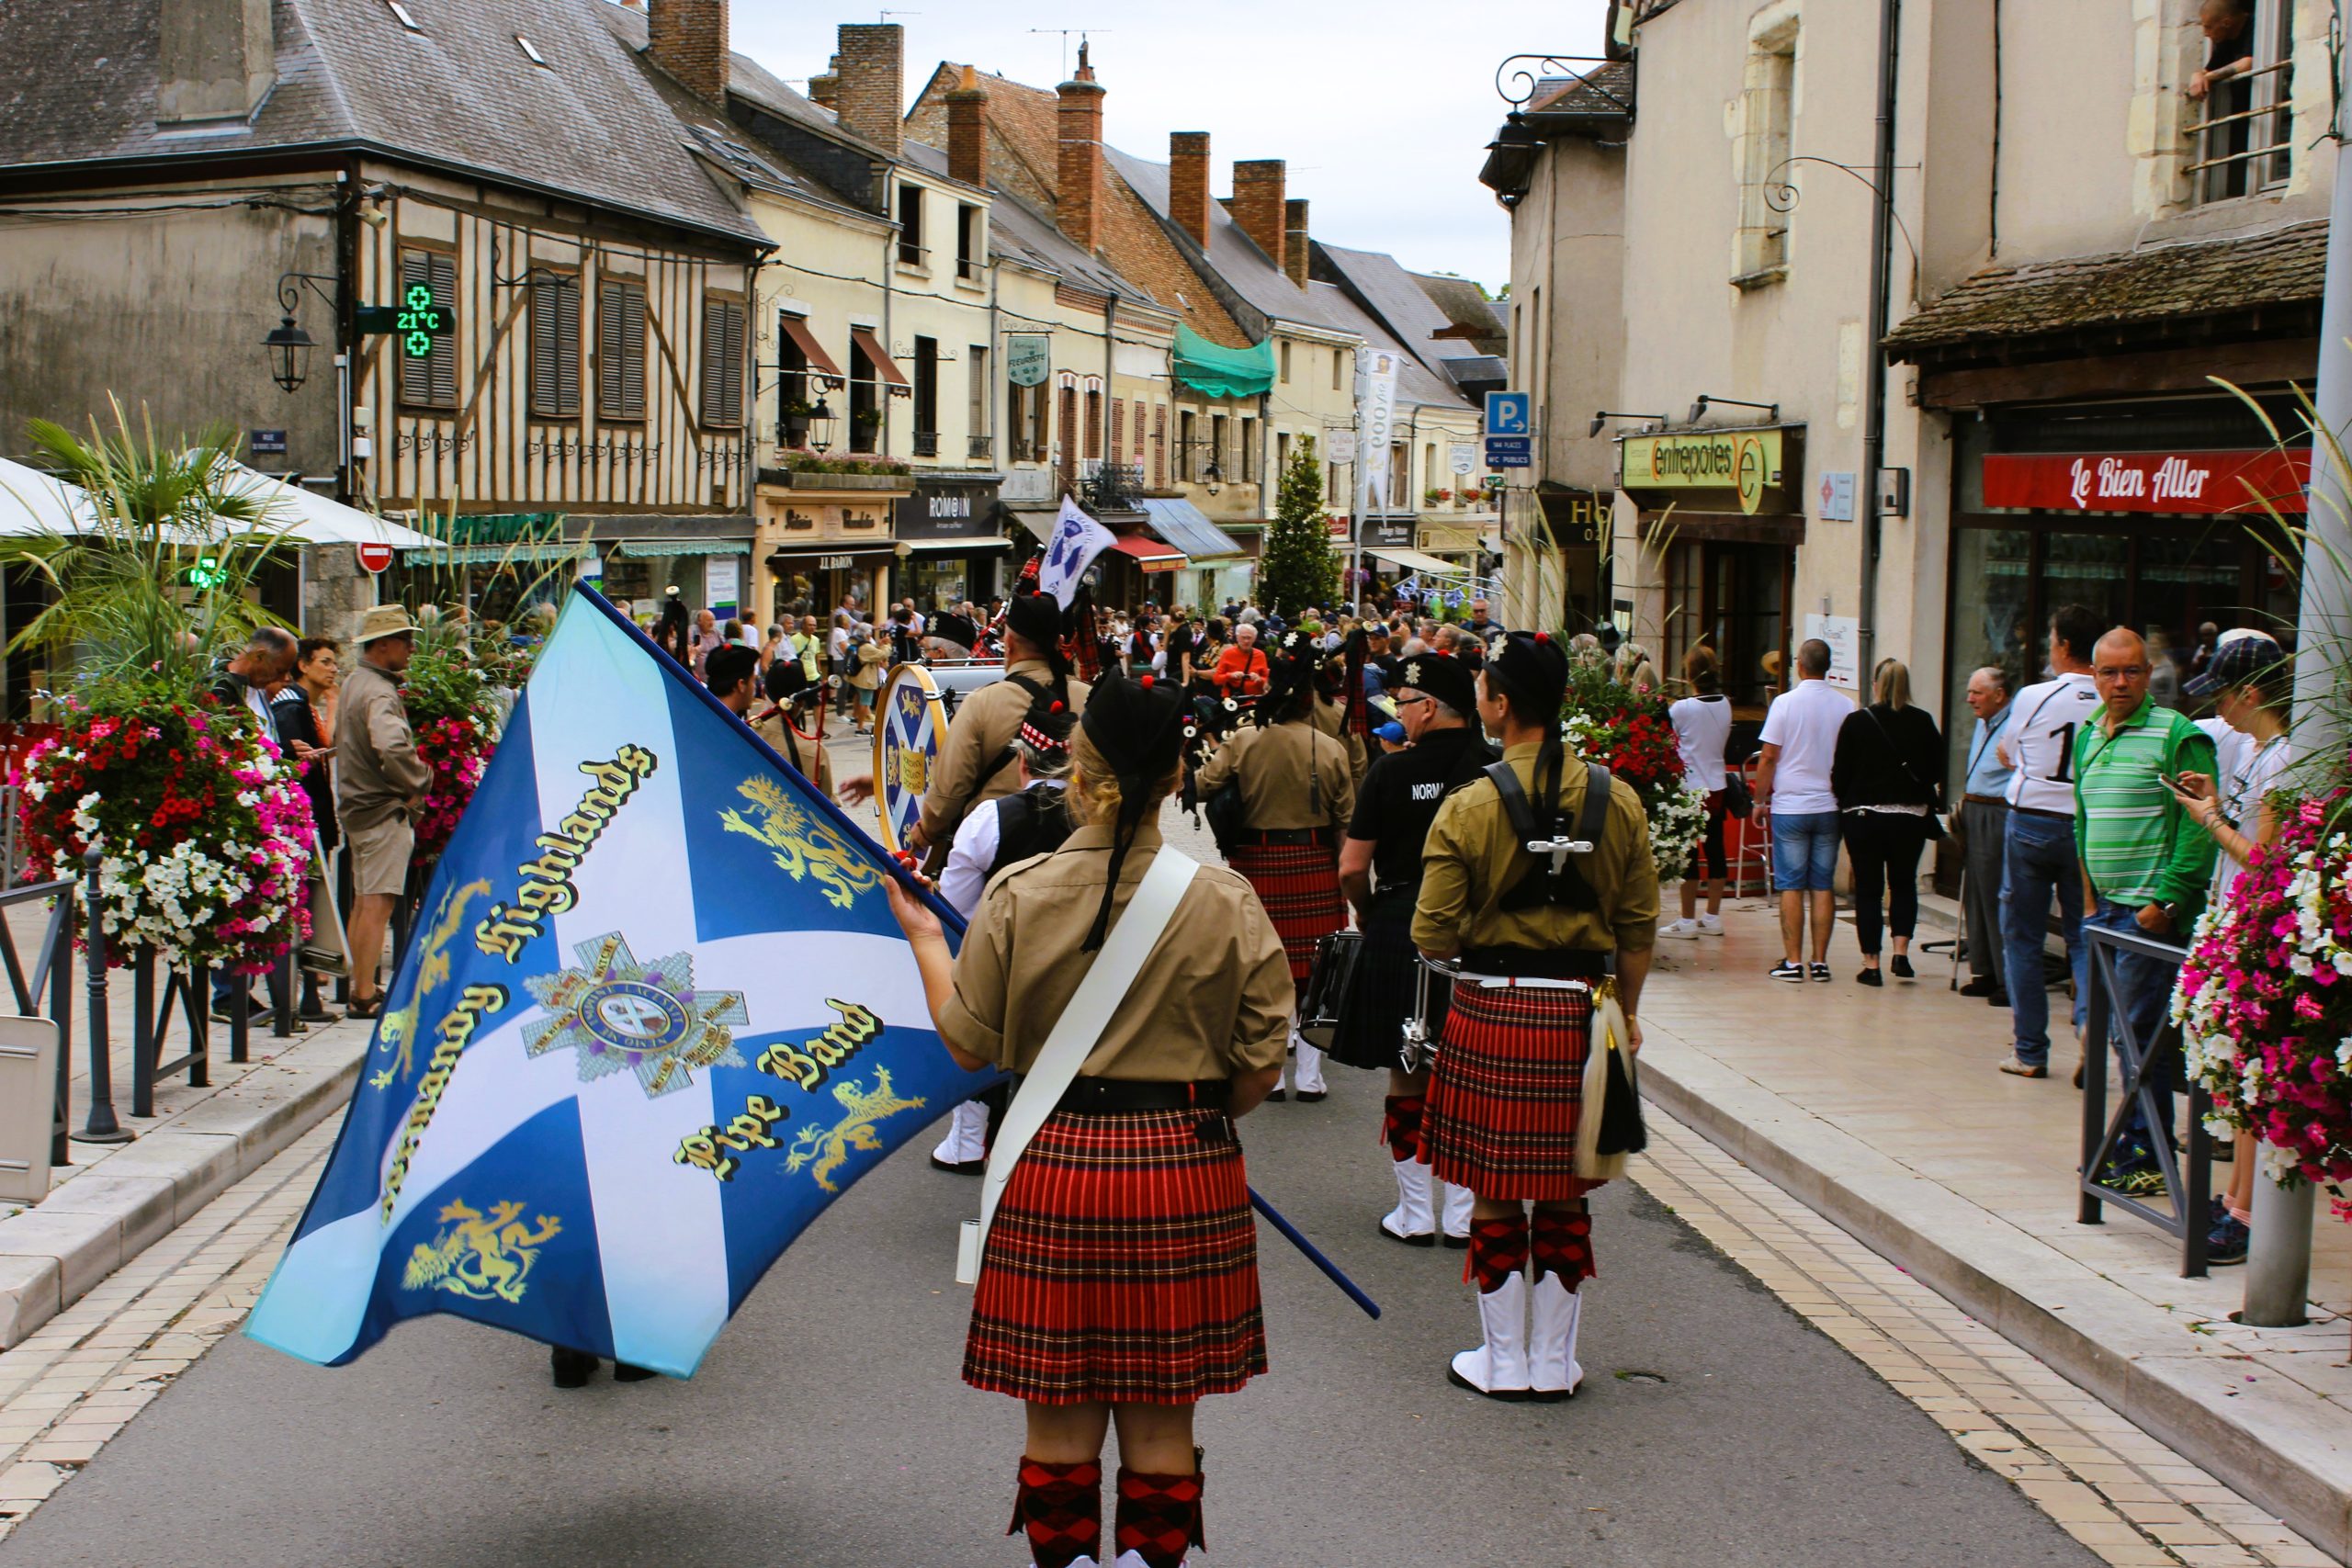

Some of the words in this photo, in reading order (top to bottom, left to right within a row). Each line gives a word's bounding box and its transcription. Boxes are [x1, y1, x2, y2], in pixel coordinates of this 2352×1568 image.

[397, 311, 439, 330] 21°C
[1498, 400, 1518, 428] P
[1504, 441, 1522, 449] PLACES
[1502, 456, 1530, 464] PUBLICS
[2070, 457, 2092, 509] Le
[2098, 457, 2146, 498] Bien
[2152, 456, 2211, 503] Aller
[929, 496, 971, 518] ROM@IN
[830, 555, 854, 570] BARON
[1411, 782, 1444, 801] NORM
[474, 742, 659, 966] Highlands
[594, 944, 614, 979] WATCH
[673, 1093, 791, 1183] Pipe
[755, 997, 885, 1094] Band
